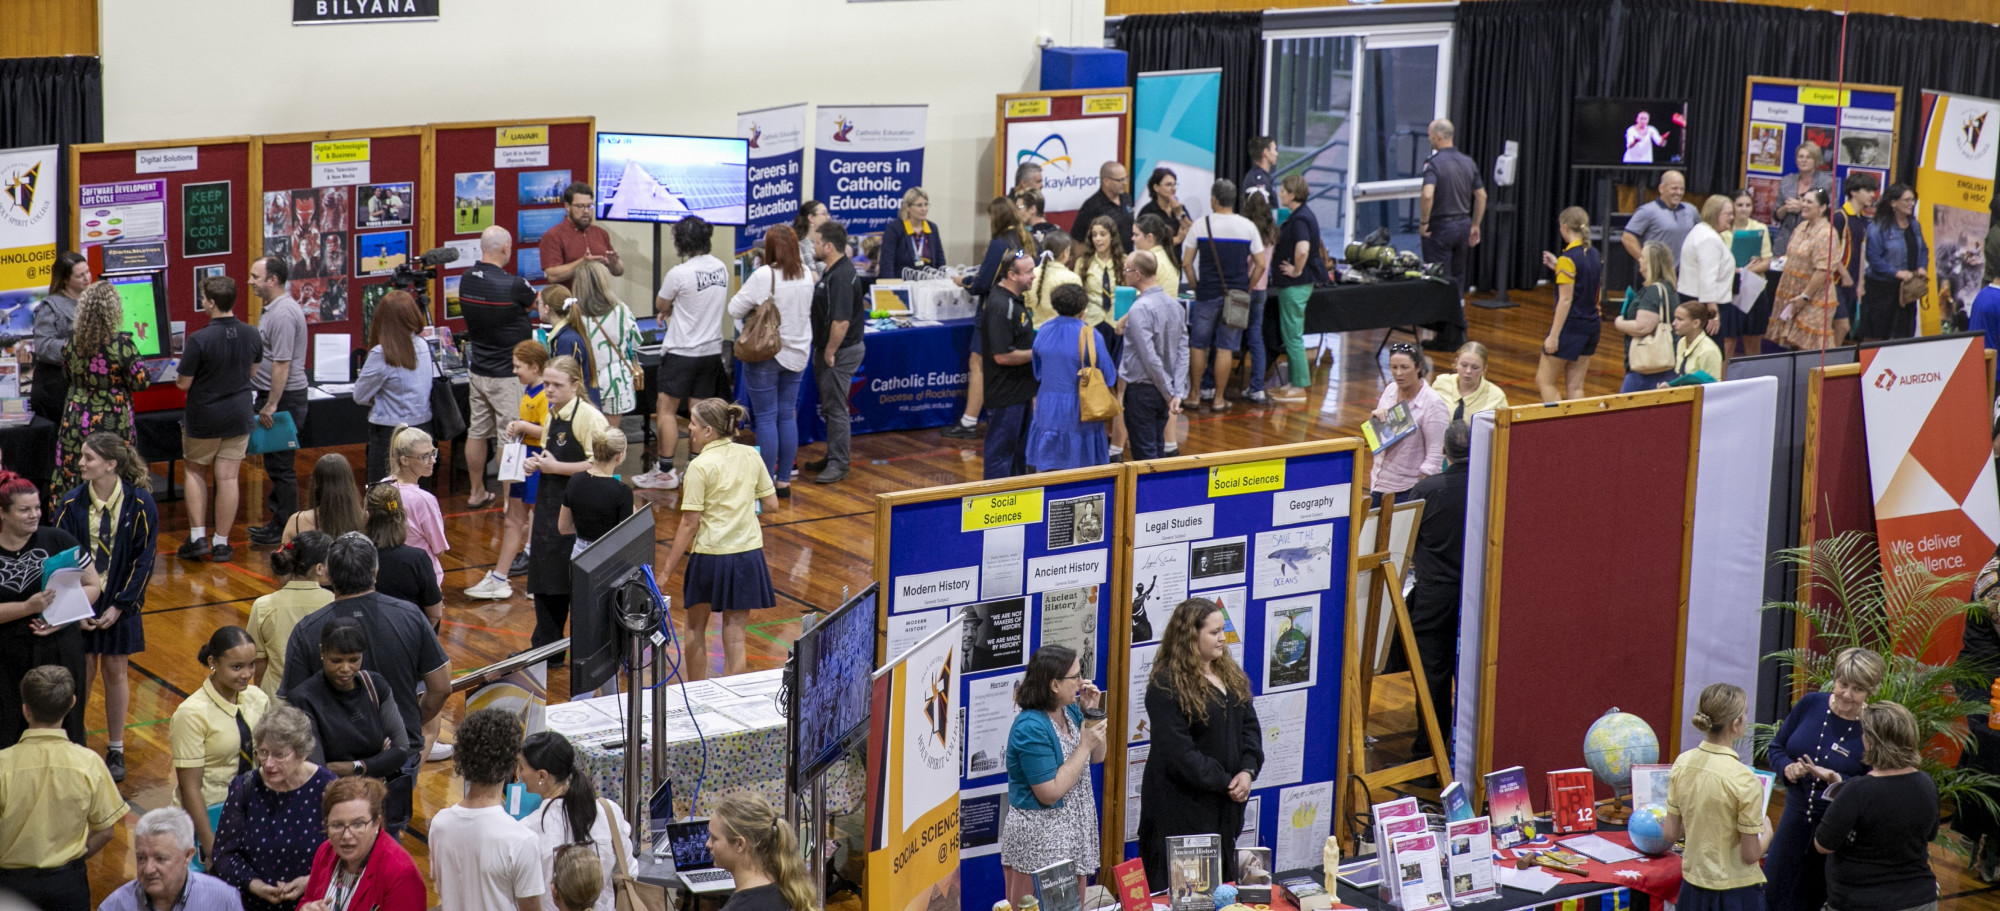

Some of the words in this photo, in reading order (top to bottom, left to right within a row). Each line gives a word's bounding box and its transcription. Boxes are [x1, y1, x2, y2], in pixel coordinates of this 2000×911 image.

[316, 0, 416, 15] BILYANA
[1767, 107, 1788, 115] English
[1844, 113, 1869, 121] Essential
[1870, 115, 1892, 123] English
[140, 156, 162, 165] Digital
[163, 154, 194, 162] Solutions
[829, 158, 892, 174] Careers
[895, 158, 910, 173] in
[748, 163, 786, 182] Careers
[788, 160, 798, 174] in
[752, 179, 794, 200] Catholic
[836, 176, 902, 192] Catholic
[1044, 174, 1100, 191] kayAirpor
[1957, 180, 1987, 192] ENGLISH
[192, 190, 222, 203] KEEP
[190, 204, 224, 216] CALM
[748, 198, 798, 220] Education
[190, 225, 224, 238] CODE
[197, 239, 218, 250] ON
[0, 249, 56, 266] HNOLOGIES
[26, 266, 36, 280] @
[39, 264, 51, 276] HS
[697, 268, 726, 287] VOLCOM
[871, 374, 924, 392] Catholic
[927, 371, 971, 386] Educat
[1900, 372, 1942, 386] AURIZON
[1214, 479, 1240, 490] Social
[1242, 474, 1280, 487] Sciences
[990, 495, 1017, 509] Social
[1289, 496, 1334, 512] Geography
[984, 512, 1022, 525] Sciences
[1145, 520, 1169, 534] Legal
[1171, 516, 1203, 529] Studies
[1272, 533, 1292, 548] SAVE
[1298, 528, 1315, 540] THE
[1891, 540, 1914, 555] We
[1917, 533, 1962, 552] deliver
[1034, 565, 1068, 578] Ancient
[1068, 561, 1100, 574] History
[902, 584, 936, 597] Modern
[938, 580, 970, 592] History
[1273, 577, 1298, 587] OCEANS
[1045, 592, 1078, 604] Ancient
[1044, 602, 1077, 612] History
[994, 618, 1014, 626] MAKERS
[1006, 634, 1020, 642] MADE
[918, 733, 928, 762] HOLY
[926, 756, 945, 770] SPIRIT
[1577, 808, 1593, 822] 12
[893, 838, 919, 875] SOCIAL
[920, 806, 960, 846] SCIENCE
[938, 842, 948, 864] @
[950, 833, 960, 854] HS
[1042, 881, 1058, 889] Modern
[1058, 875, 1074, 884] History
